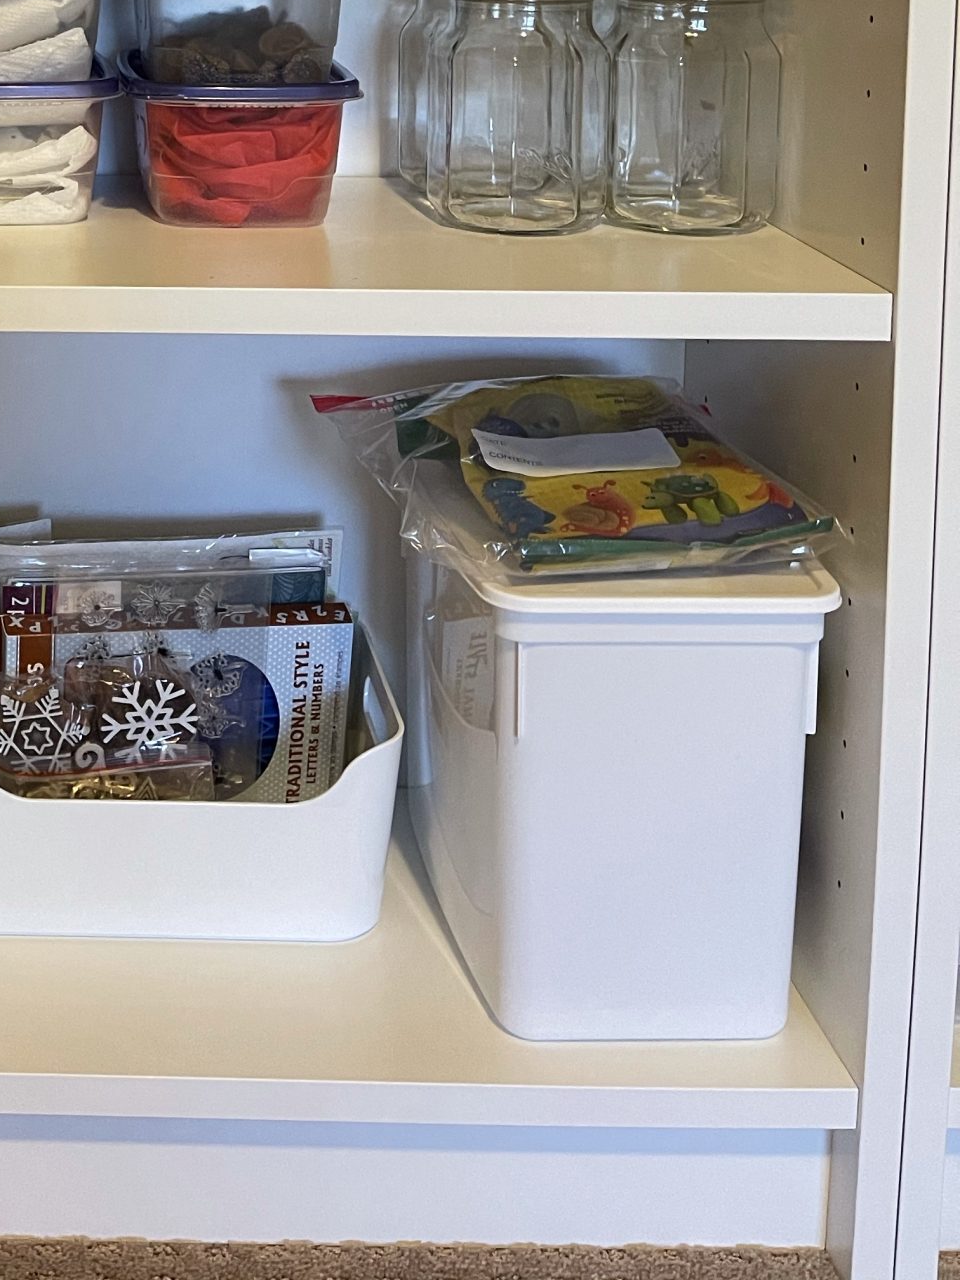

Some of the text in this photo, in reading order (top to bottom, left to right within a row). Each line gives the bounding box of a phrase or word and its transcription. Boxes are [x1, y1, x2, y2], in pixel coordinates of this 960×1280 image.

[489, 451, 545, 467] CONTENTS
[11, 597, 30, 606] 2
[8, 616, 25, 628] X
[285, 641, 310, 804] TRADITIONAL STYLE
[306, 663, 324, 784] LETTERS & NUMBERS
